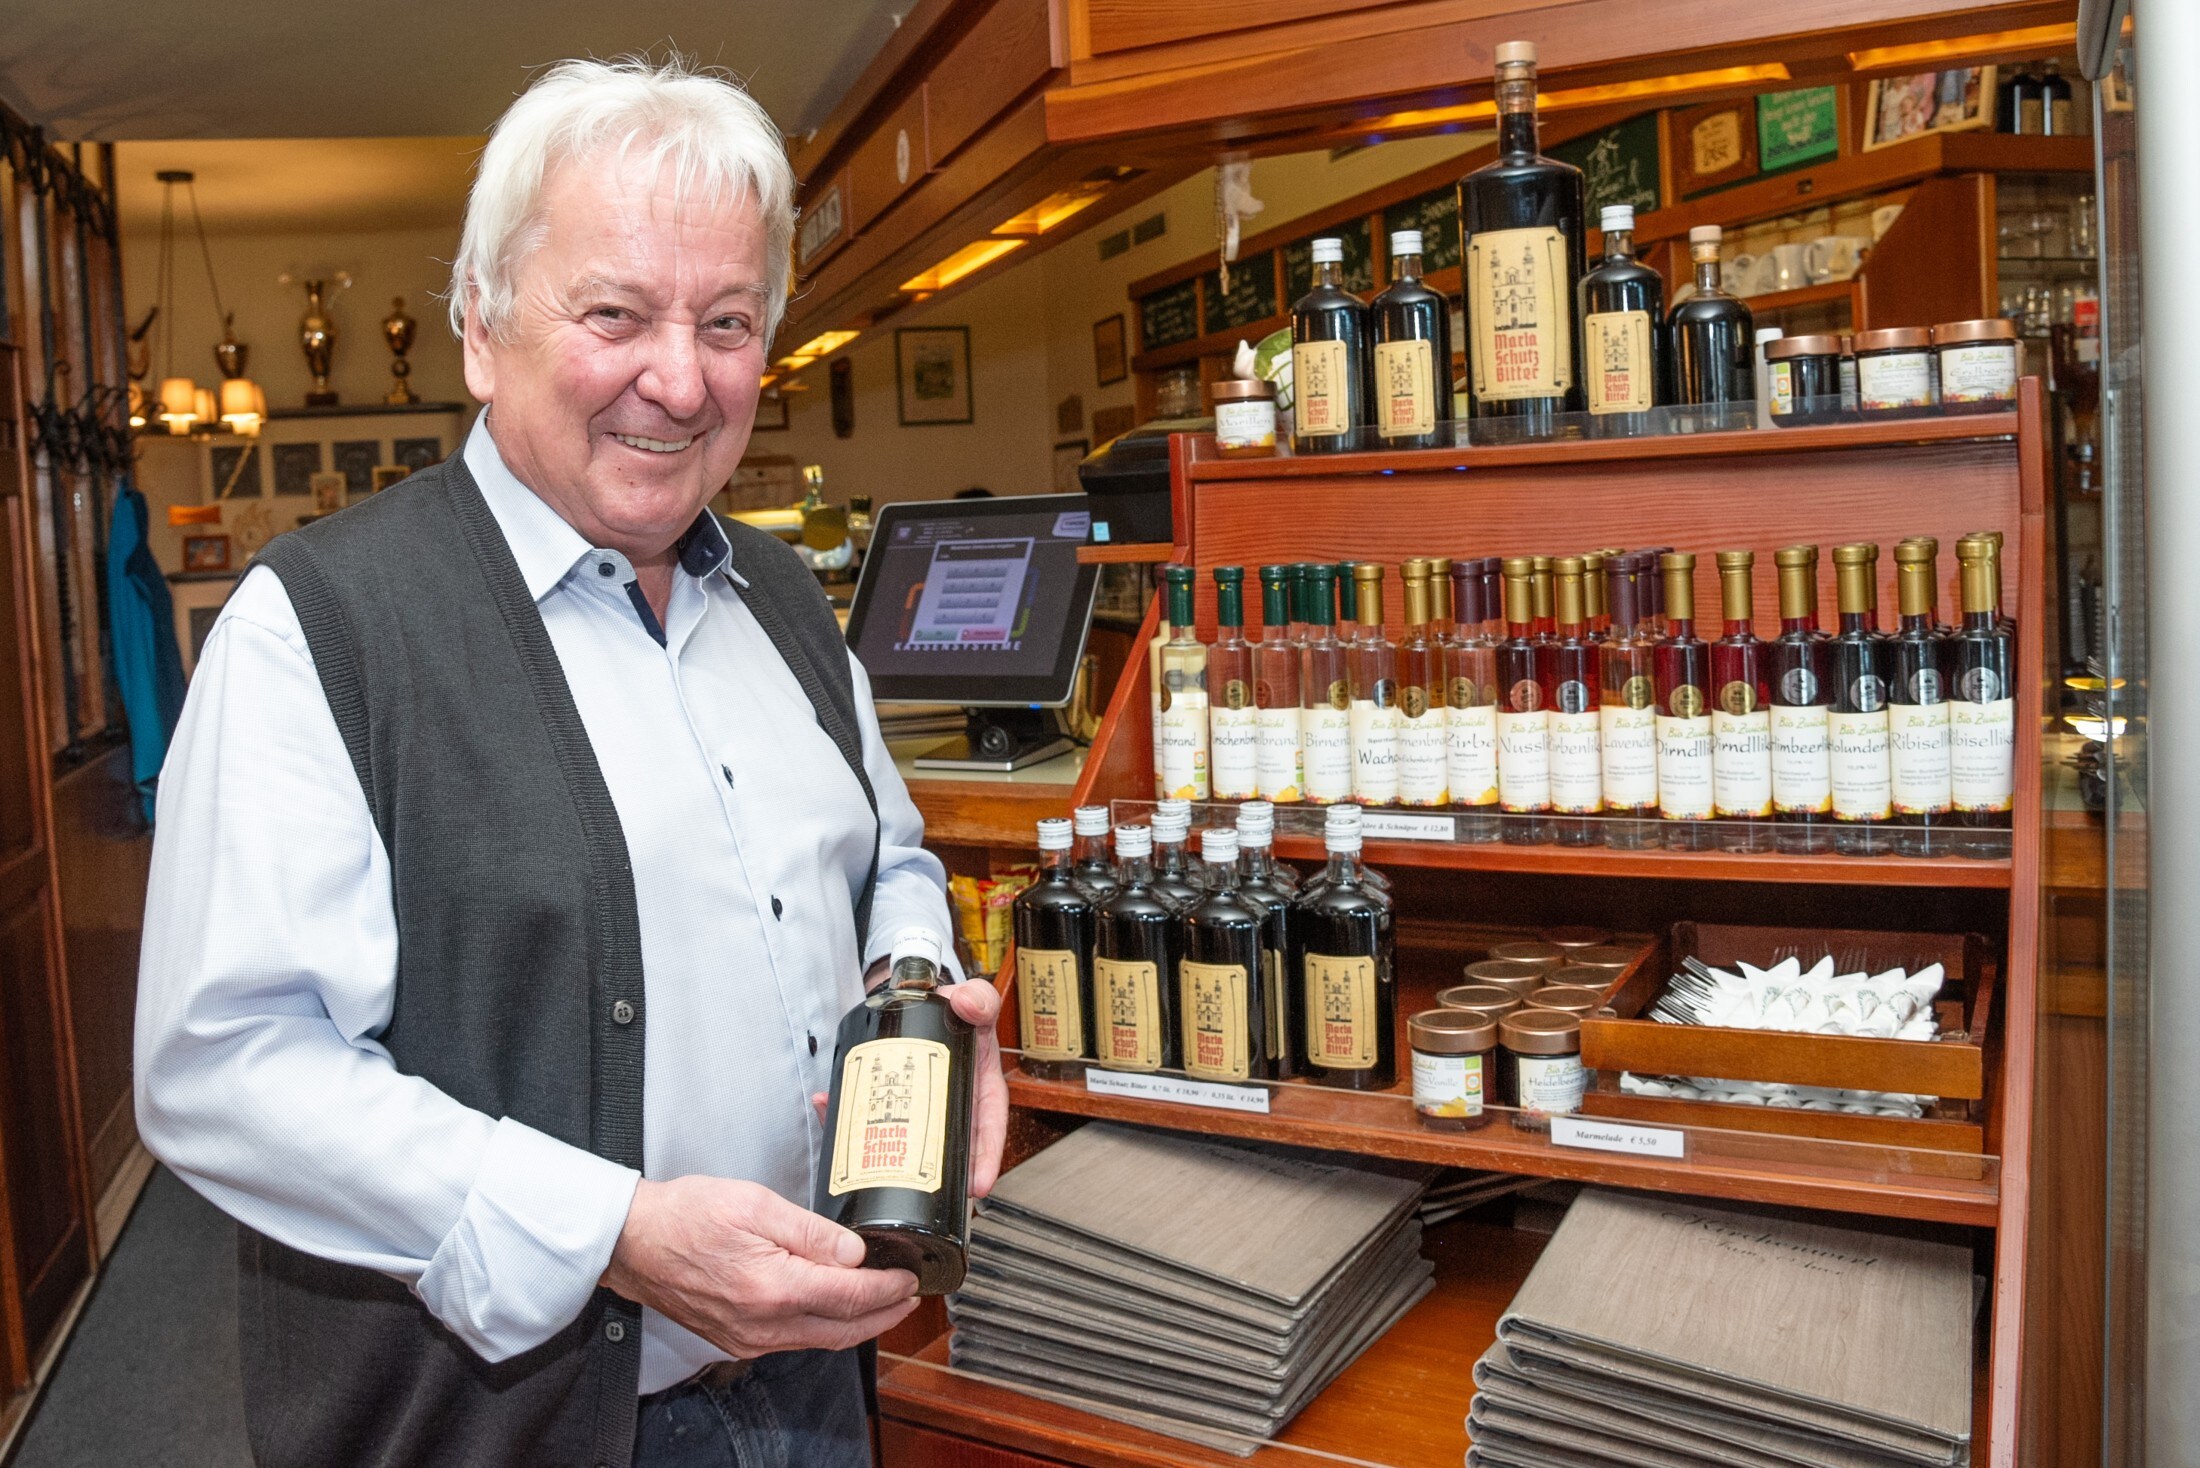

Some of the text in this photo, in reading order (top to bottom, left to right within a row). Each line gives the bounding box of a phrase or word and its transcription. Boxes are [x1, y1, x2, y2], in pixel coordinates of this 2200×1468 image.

[1494, 332, 1537, 350] Maria
[1495, 349, 1539, 367] Schutz
[1496, 366, 1539, 383] Bitter
[1604, 373, 1629, 382] Maria
[1605, 382, 1630, 393] Schutz
[1605, 392, 1630, 402] Bitter
[1358, 747, 1399, 766] Wacho
[1034, 1014, 1057, 1026] Maria
[1035, 1025, 1059, 1038] Schutz
[1112, 1025, 1136, 1038] Maria
[1325, 1023, 1352, 1035] Maria
[1035, 1035, 1059, 1047] Bitter
[1113, 1036, 1138, 1050] Schutz
[1197, 1032, 1223, 1045] Maria
[1325, 1033, 1353, 1046] Schutz
[1113, 1046, 1137, 1059] Bitter
[1197, 1042, 1224, 1057] Schutz
[1326, 1043, 1353, 1055] Bitter
[1198, 1053, 1224, 1066] Bitter
[1089, 1077, 1108, 1086] Maria
[1109, 1079, 1129, 1088] Schutz
[1131, 1082, 1148, 1090] Bitter
[864, 1125, 907, 1141] Maria
[1575, 1130, 1623, 1143] Marmelade
[1638, 1137, 1657, 1146] 5,50
[863, 1139, 907, 1155] Schutz
[861, 1154, 906, 1169] Bitter
[1661, 1211, 1878, 1267] Kirchenwirt
